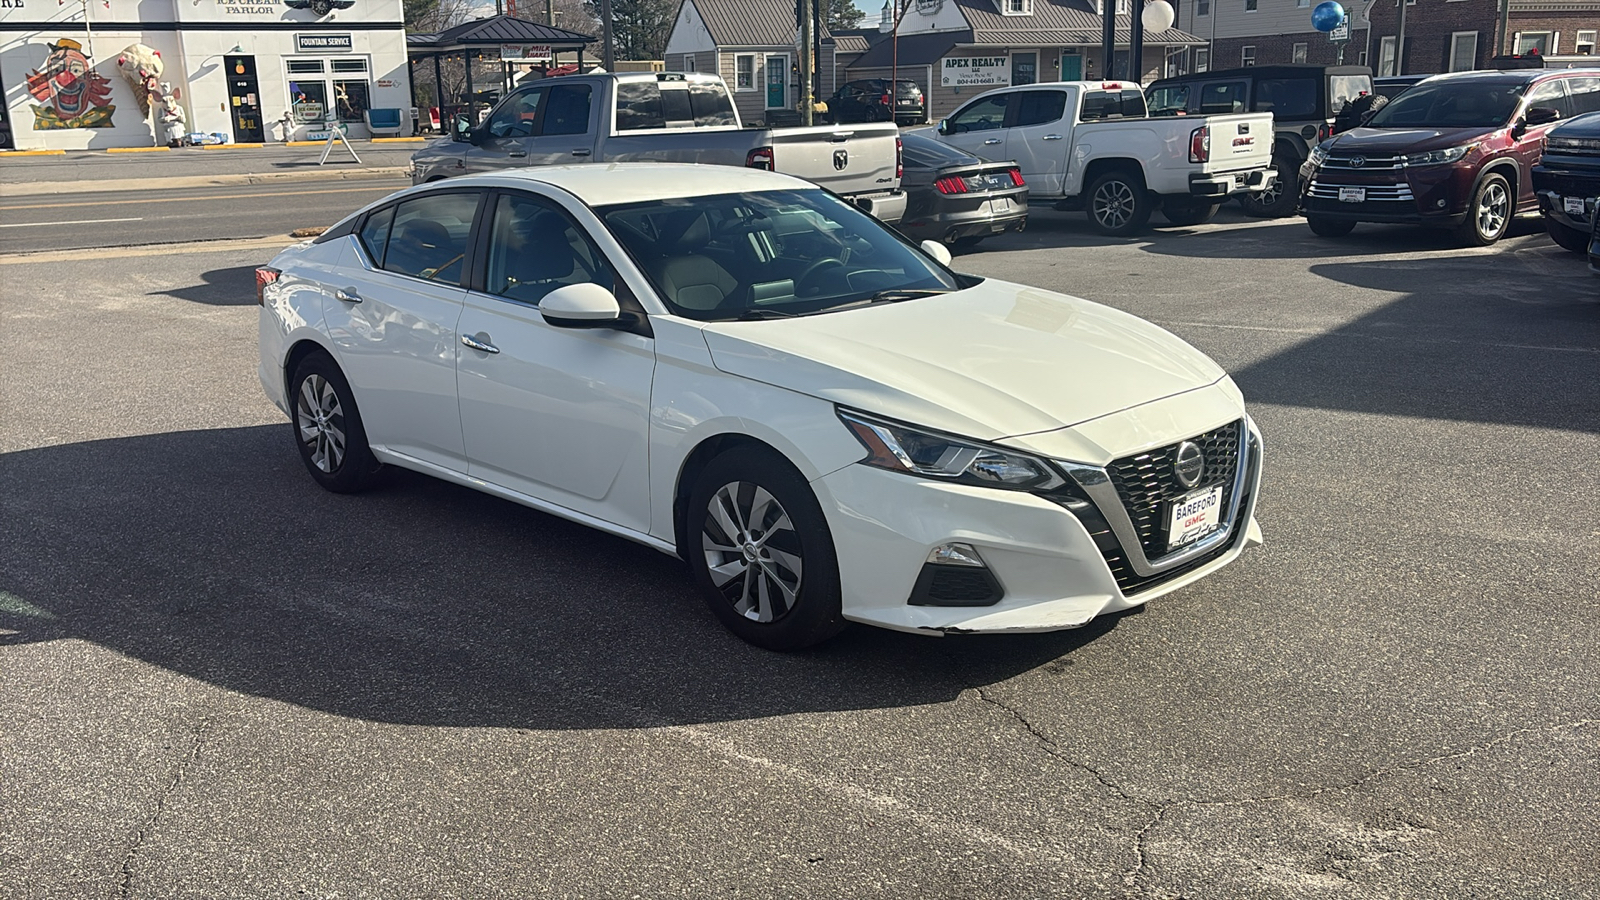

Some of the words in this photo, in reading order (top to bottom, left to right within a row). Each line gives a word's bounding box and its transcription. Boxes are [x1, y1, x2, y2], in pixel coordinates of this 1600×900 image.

[300, 37, 327, 46] FOUNTAIN
[328, 37, 350, 46] SERVICE
[945, 58, 969, 68] APEX
[971, 57, 1006, 67] REALTY
[1232, 137, 1255, 147] GMC
[1177, 494, 1216, 520] BAREFORD
[1185, 513, 1205, 527] GMC
